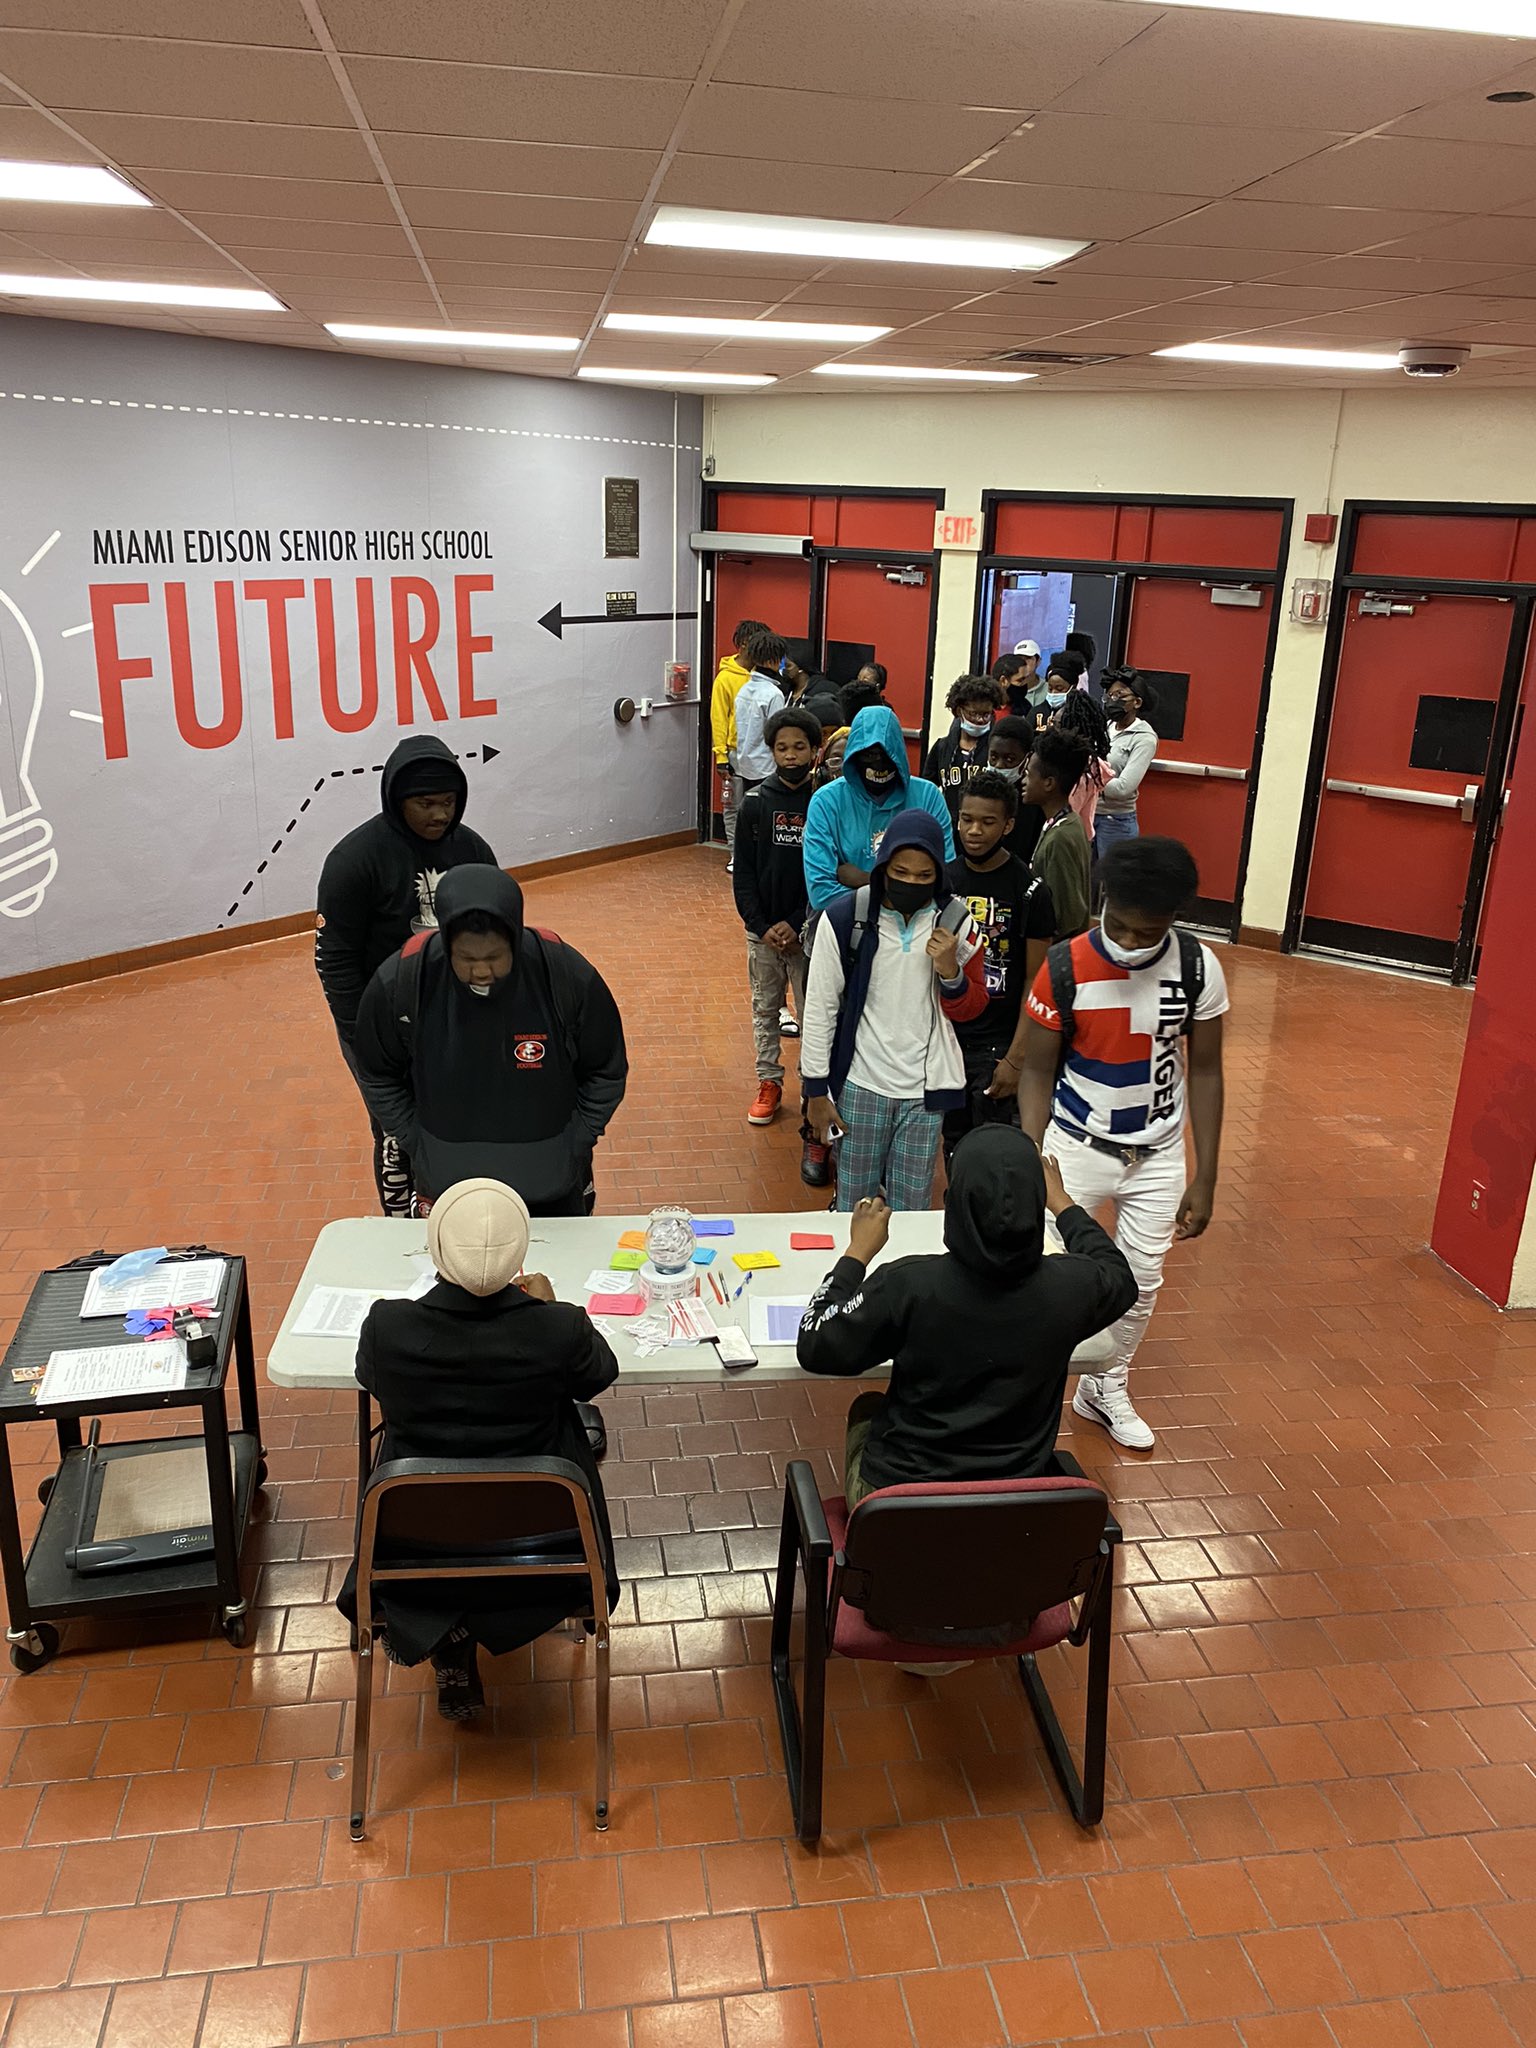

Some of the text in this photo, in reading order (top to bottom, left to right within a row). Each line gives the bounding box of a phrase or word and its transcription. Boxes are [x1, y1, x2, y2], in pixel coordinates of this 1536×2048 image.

[93, 529, 493, 564] MIAMI EDISON SENIOR HIGH SCHOOL
[944, 516, 973, 544] EXIT
[89, 574, 498, 760] FUTURE
